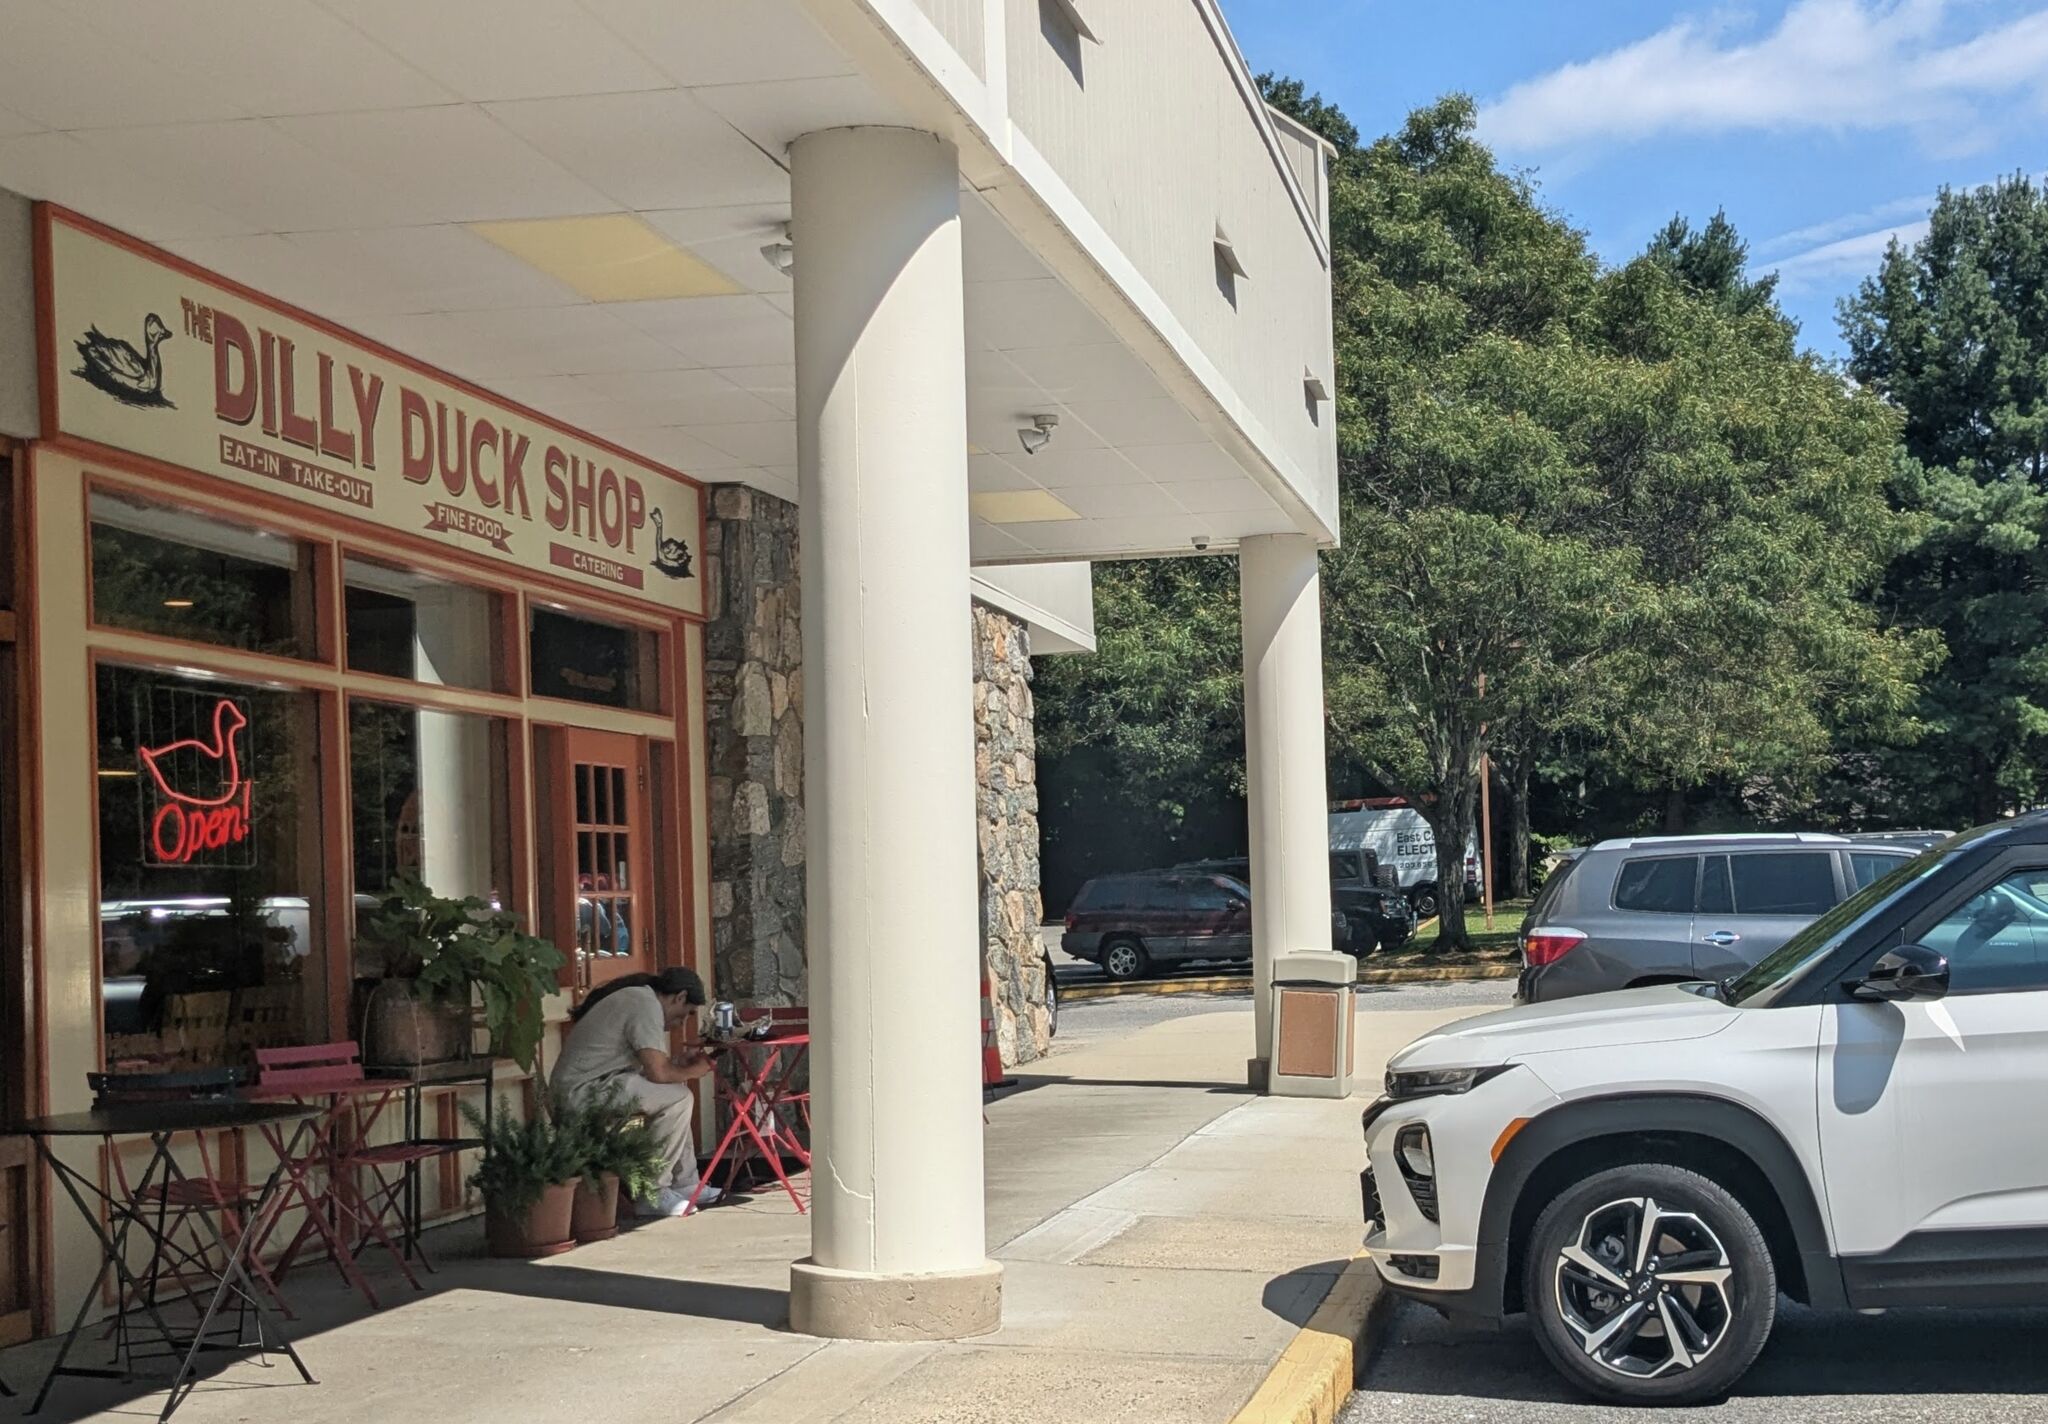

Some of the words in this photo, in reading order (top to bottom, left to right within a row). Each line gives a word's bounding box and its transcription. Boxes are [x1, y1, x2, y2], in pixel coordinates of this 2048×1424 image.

[181, 296, 214, 345] THE
[212, 309, 384, 472] DILLY
[400, 385, 533, 522] DUCK
[545, 445, 646, 554] SHOP
[222, 438, 281, 478] EAT-IN
[291, 462, 371, 504] TAKE-OUT
[437, 505, 466, 530] FINE
[468, 515, 502, 541] FOOD
[573, 552, 624, 581] CATERING
[153, 777, 252, 862] Open!
[1397, 832, 1422, 843] East
[1423, 830, 1436, 842] Co
[1397, 843, 1435, 856] ELECT
